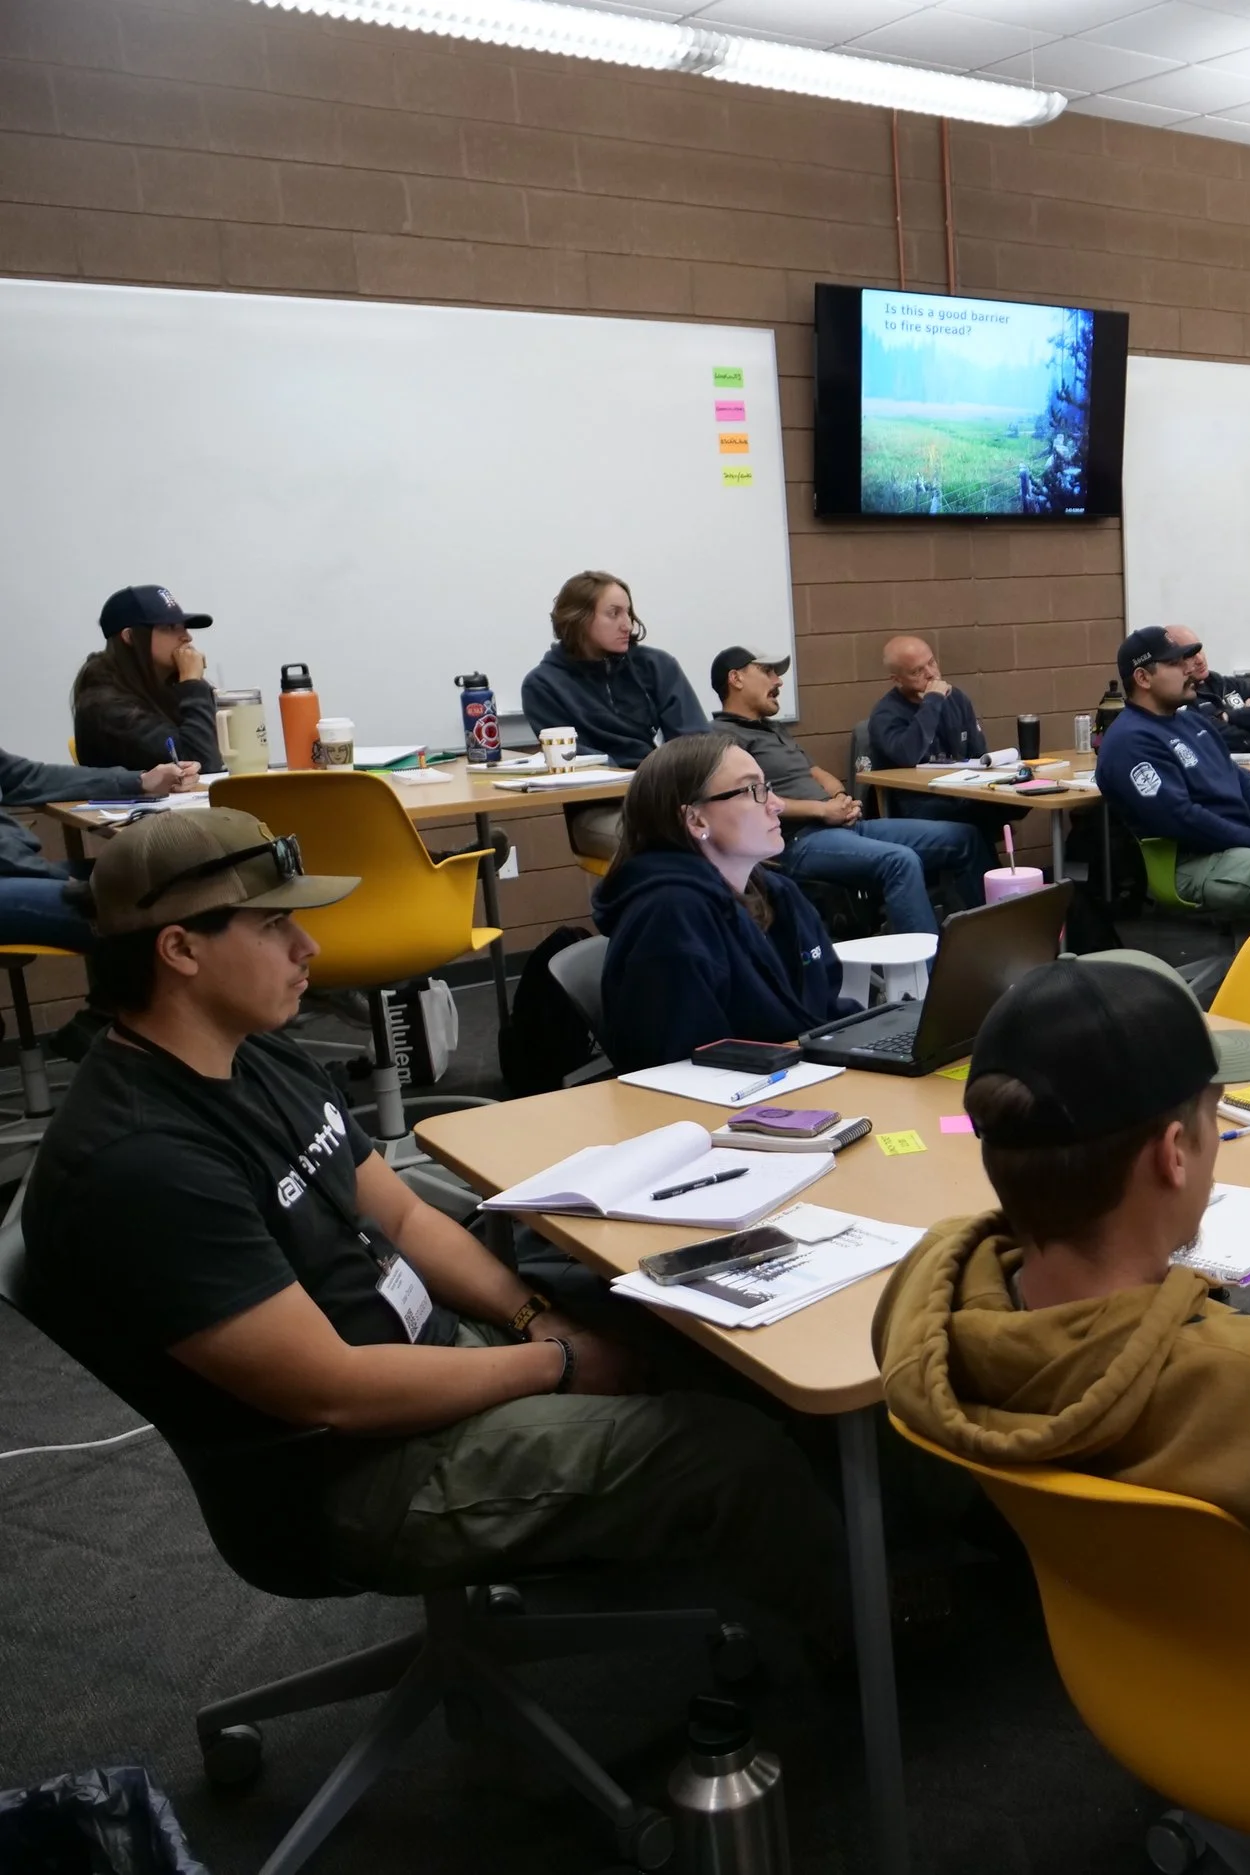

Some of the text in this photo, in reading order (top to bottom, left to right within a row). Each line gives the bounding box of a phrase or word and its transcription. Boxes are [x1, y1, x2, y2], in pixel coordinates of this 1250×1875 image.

[884, 303, 1010, 324] Is this a good barrier
[884, 319, 972, 336] to fire spread?
[388, 1004, 414, 1085] lululem
